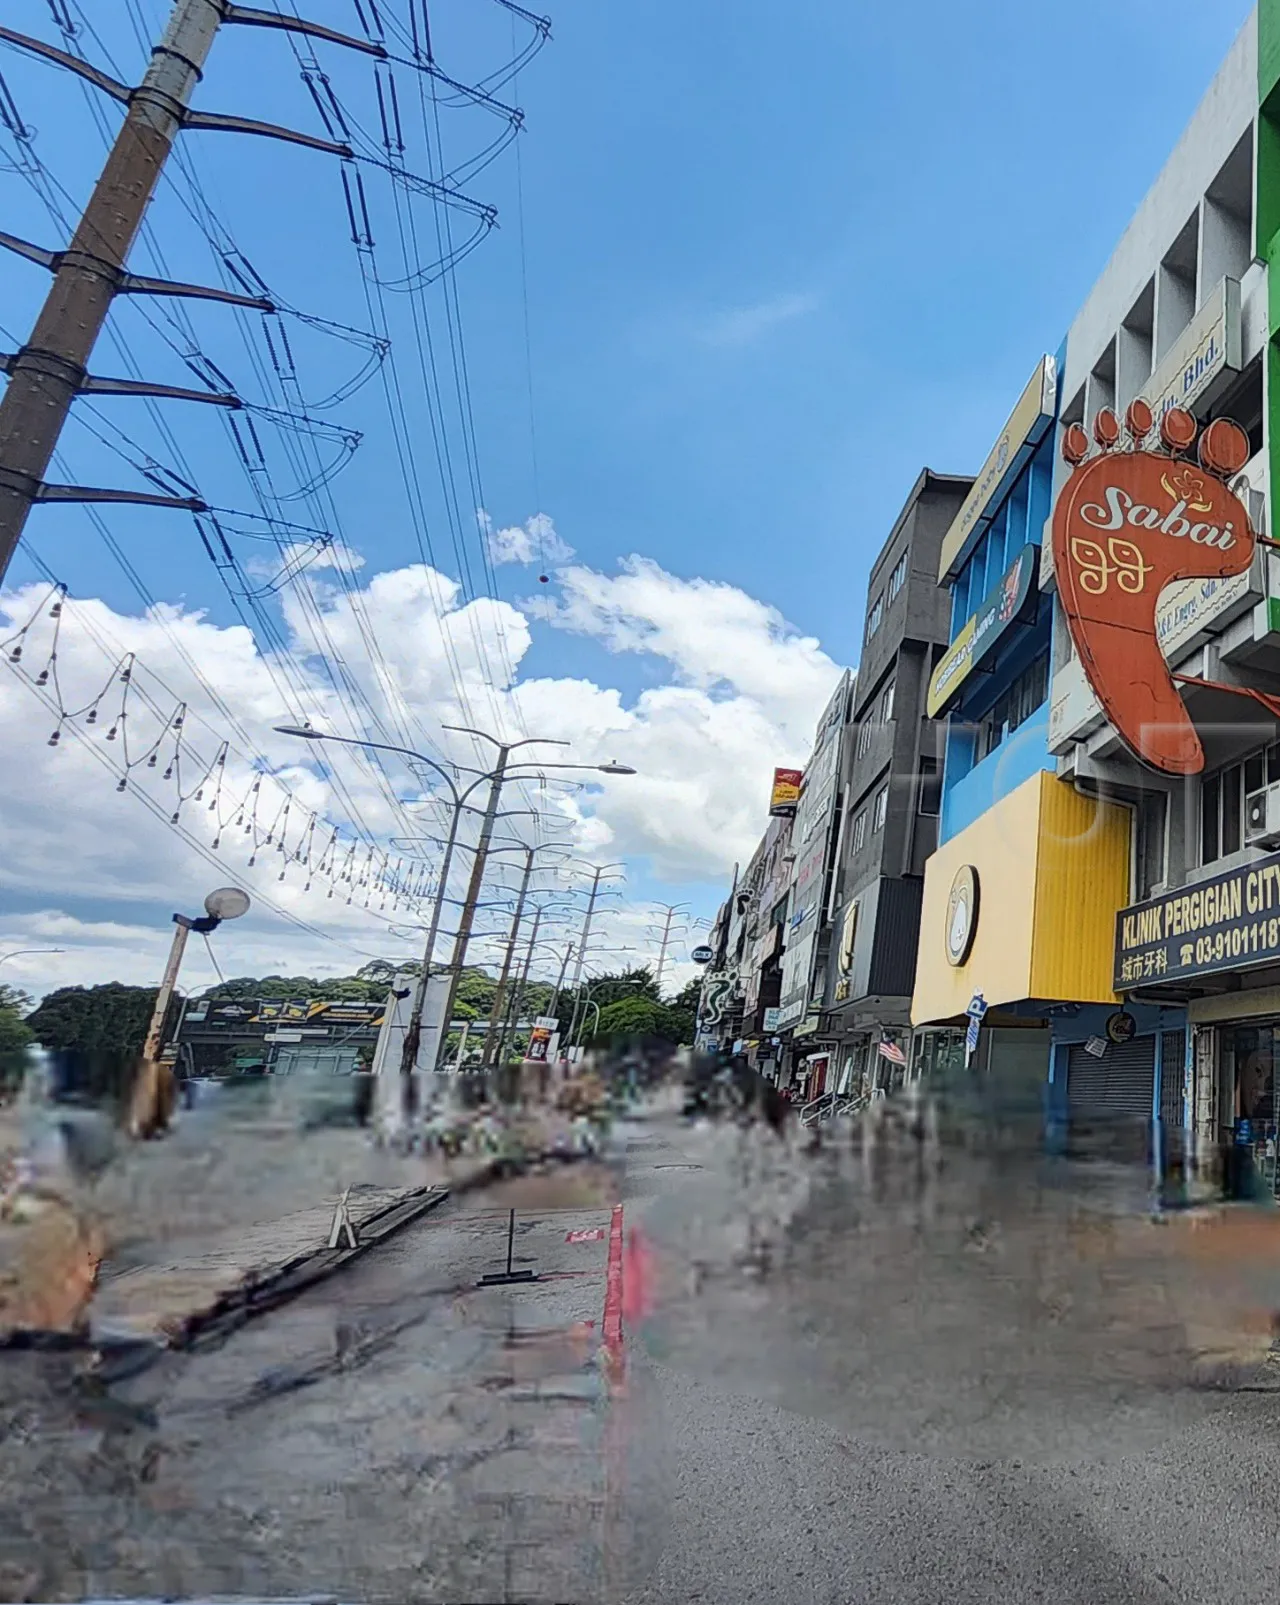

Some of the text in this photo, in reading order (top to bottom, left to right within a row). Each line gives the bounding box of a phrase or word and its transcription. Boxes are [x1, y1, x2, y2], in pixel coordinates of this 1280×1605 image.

[1080, 486, 1237, 550] Sabai
[1122, 905, 1163, 950] KLINIK
[1164, 877, 1243, 938] PERGIGIAN
[1121, 946, 1168, 982] 城市牙科
